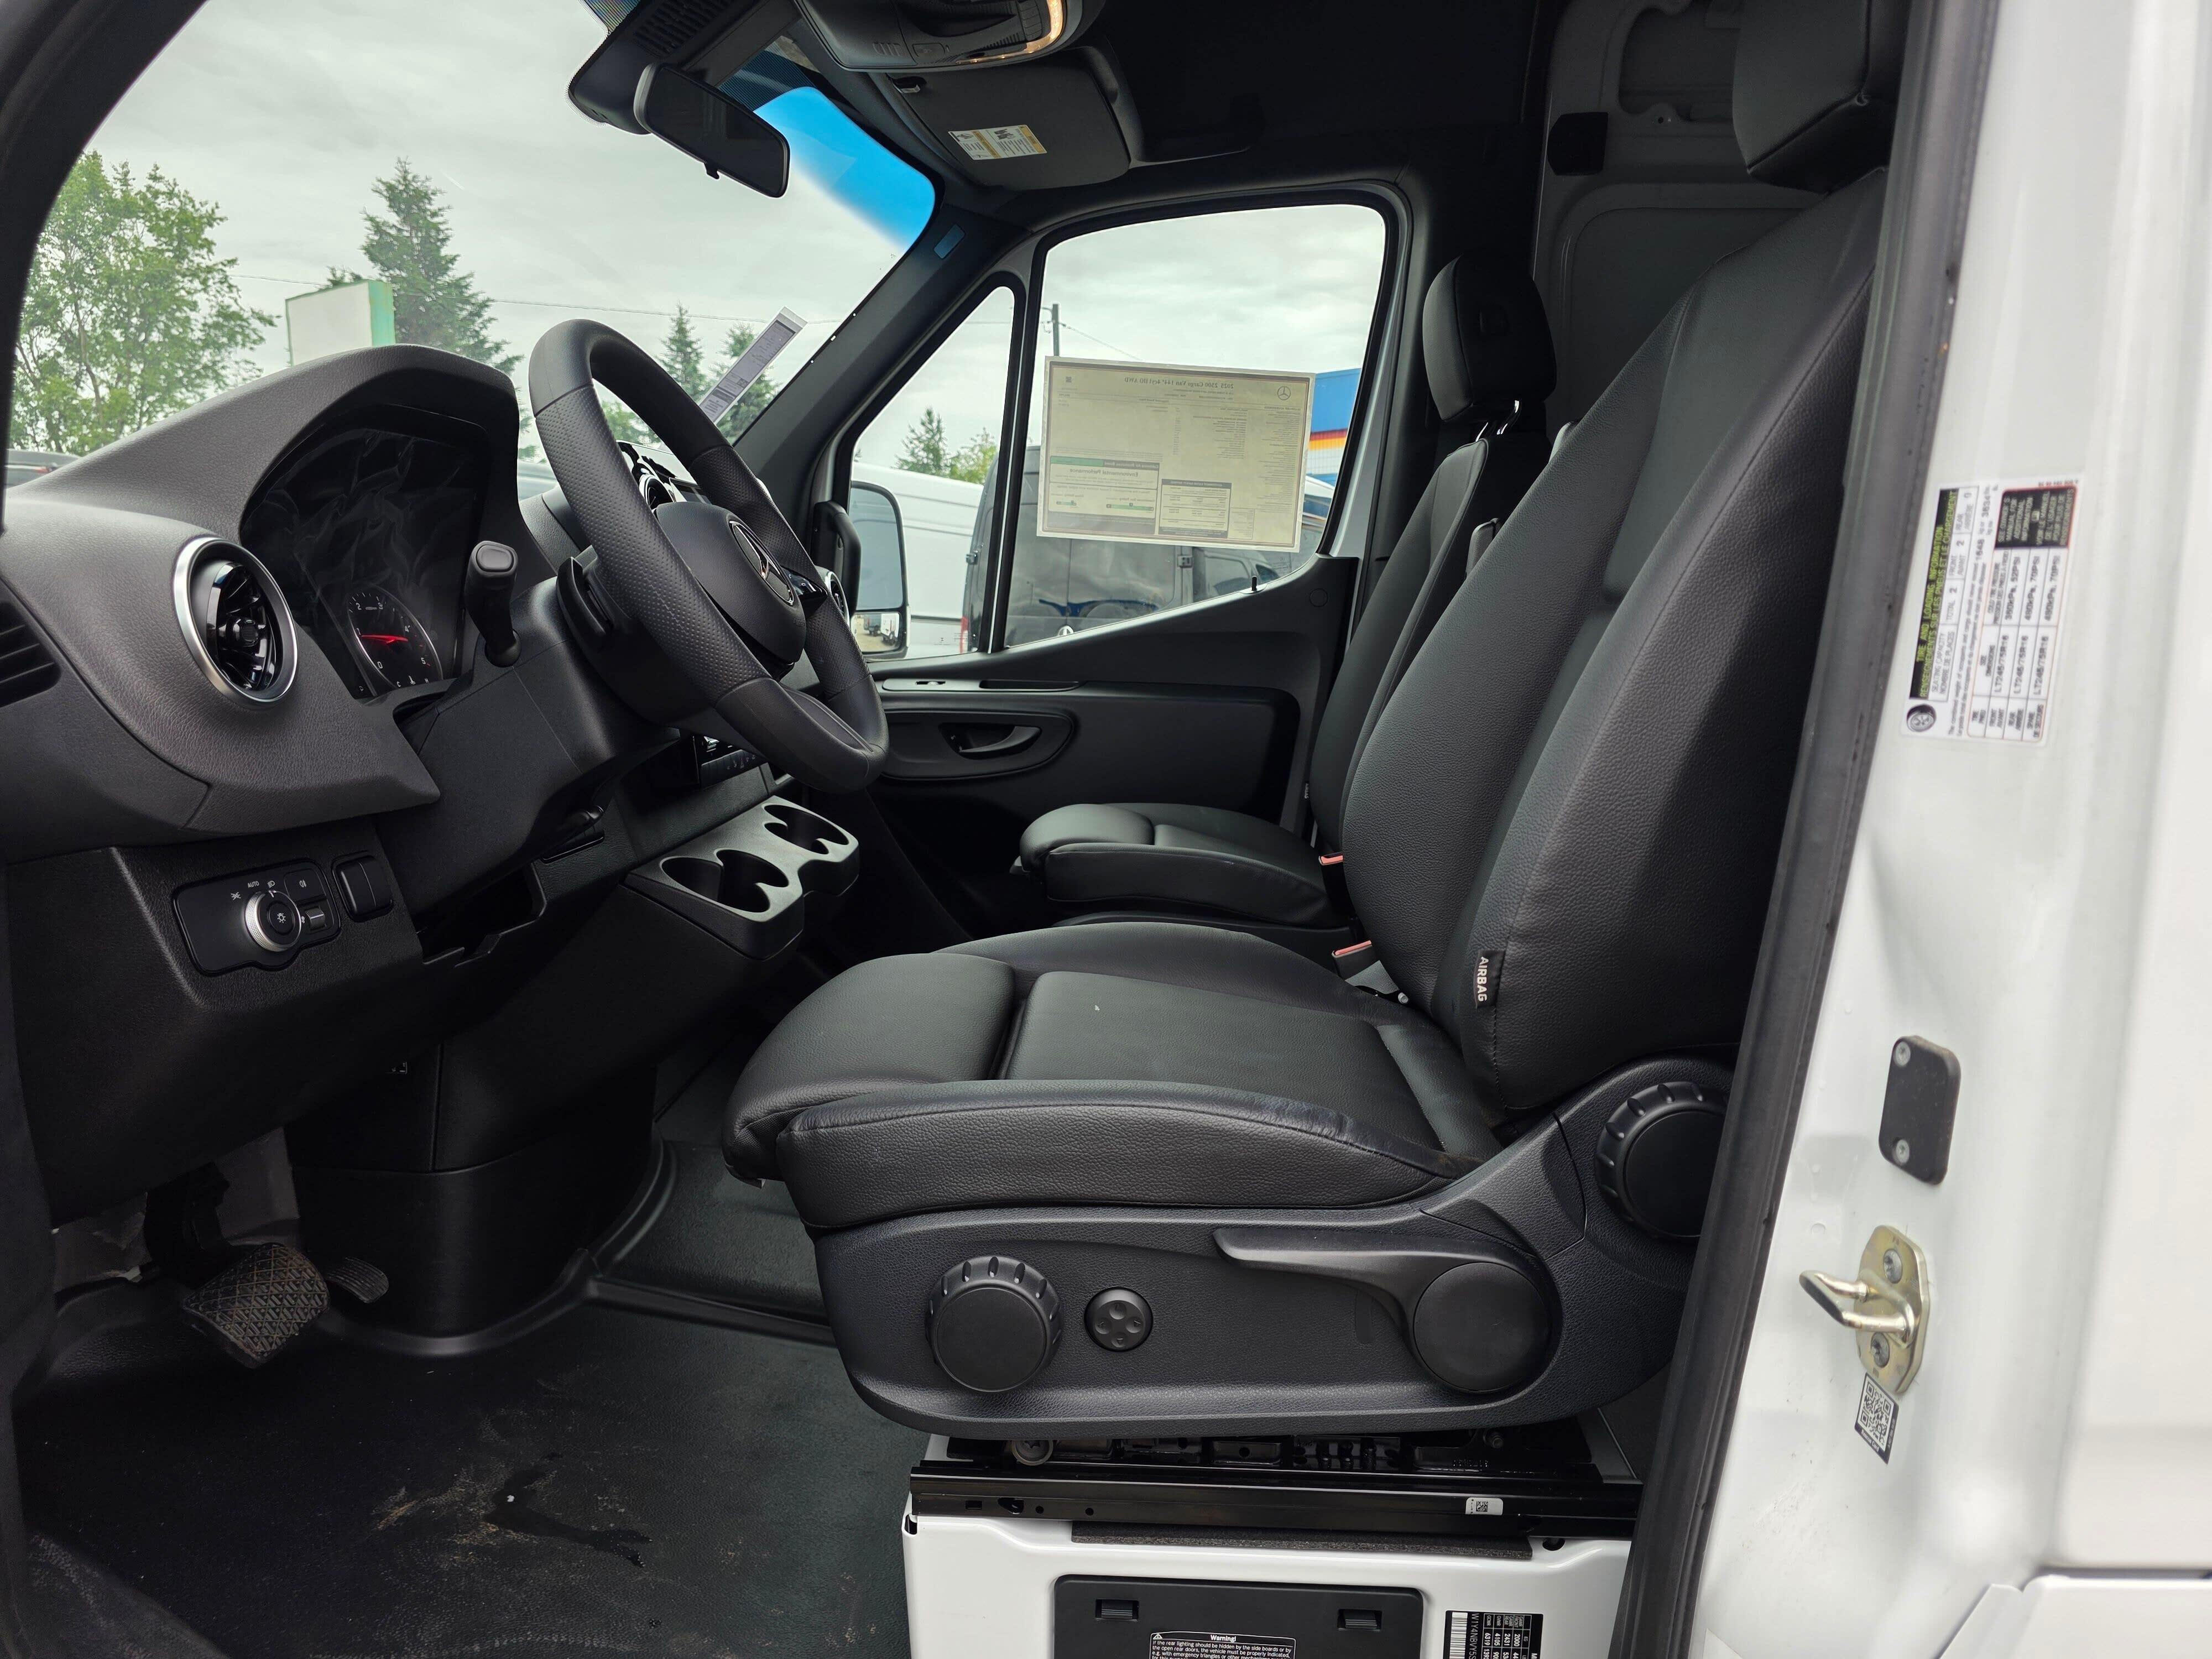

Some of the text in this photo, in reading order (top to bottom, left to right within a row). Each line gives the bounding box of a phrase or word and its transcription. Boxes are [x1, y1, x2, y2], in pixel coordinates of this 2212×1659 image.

[1916, 526, 1944, 661] TIRE AND LOADING INFORMATION
[1477, 956, 1489, 1001] AIRBAG
[1210, 1634, 1237, 1642] Warning!
